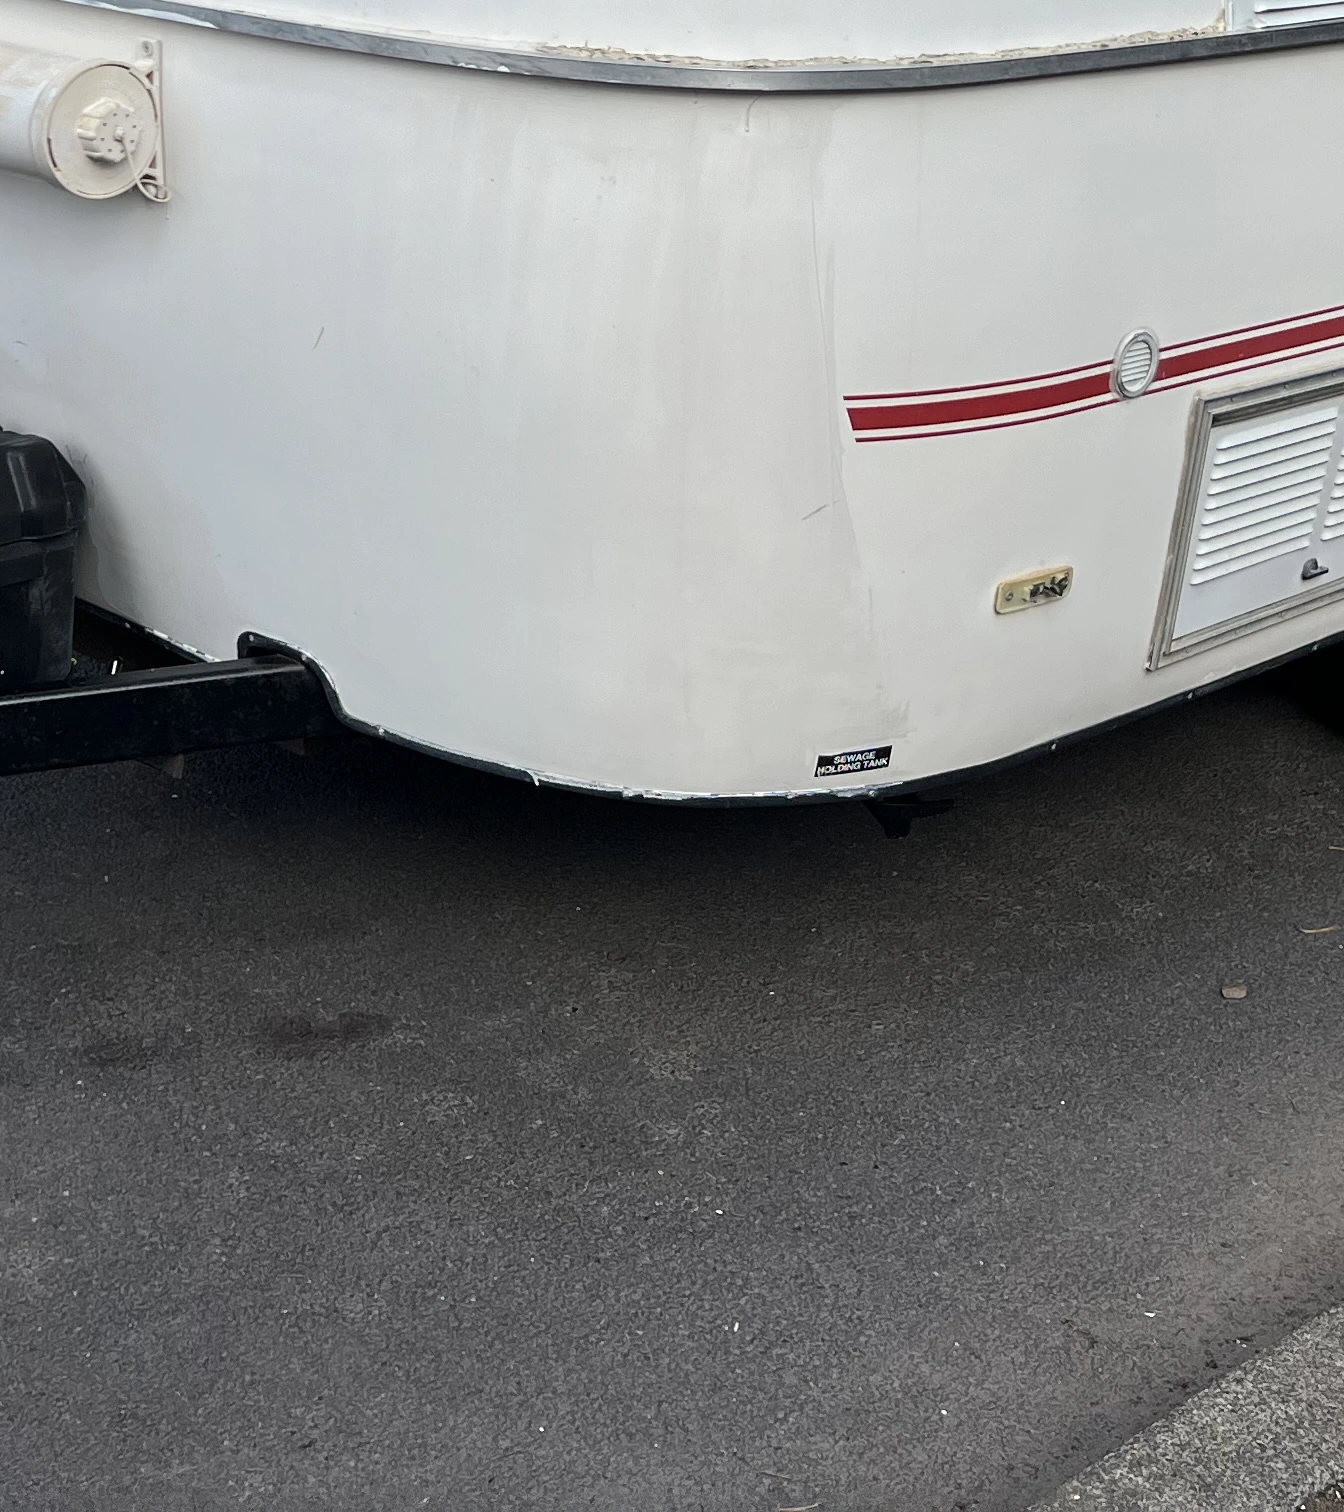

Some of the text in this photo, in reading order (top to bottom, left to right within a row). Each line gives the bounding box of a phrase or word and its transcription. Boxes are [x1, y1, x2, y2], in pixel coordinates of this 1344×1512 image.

[834, 751, 876, 764] SEWAGE
[817, 757, 888, 776] HOLDING TANK
